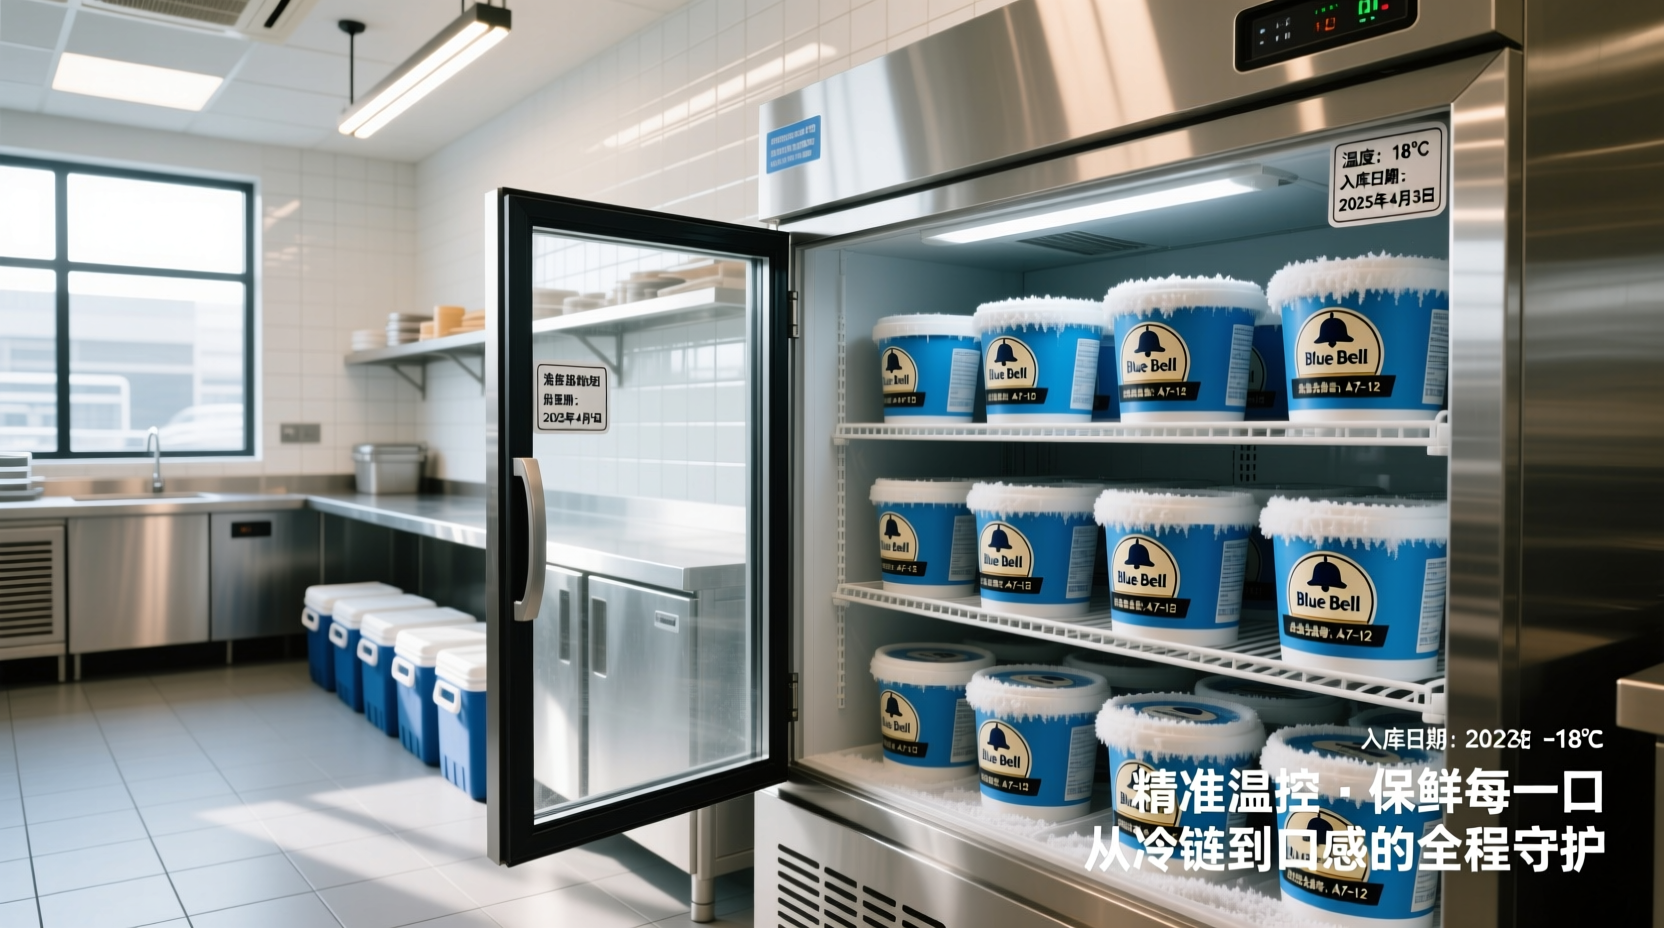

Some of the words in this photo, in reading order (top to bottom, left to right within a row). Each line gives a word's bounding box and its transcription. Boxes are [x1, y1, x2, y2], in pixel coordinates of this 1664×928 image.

[1305, 351, 1334, 366] Blue
[1336, 349, 1368, 365] Bell
[1007, 367, 1027, 379] Bell
[1126, 360, 1148, 374] Blue
[1150, 358, 1176, 372] Bell
[1002, 555, 1022, 568] Bell
[1118, 570, 1138, 586] Blue
[1140, 573, 1166, 588] Bell
[1296, 591, 1326, 609] Blue
[1330, 596, 1360, 612] Bell
[1000, 754, 1020, 768] Bell
